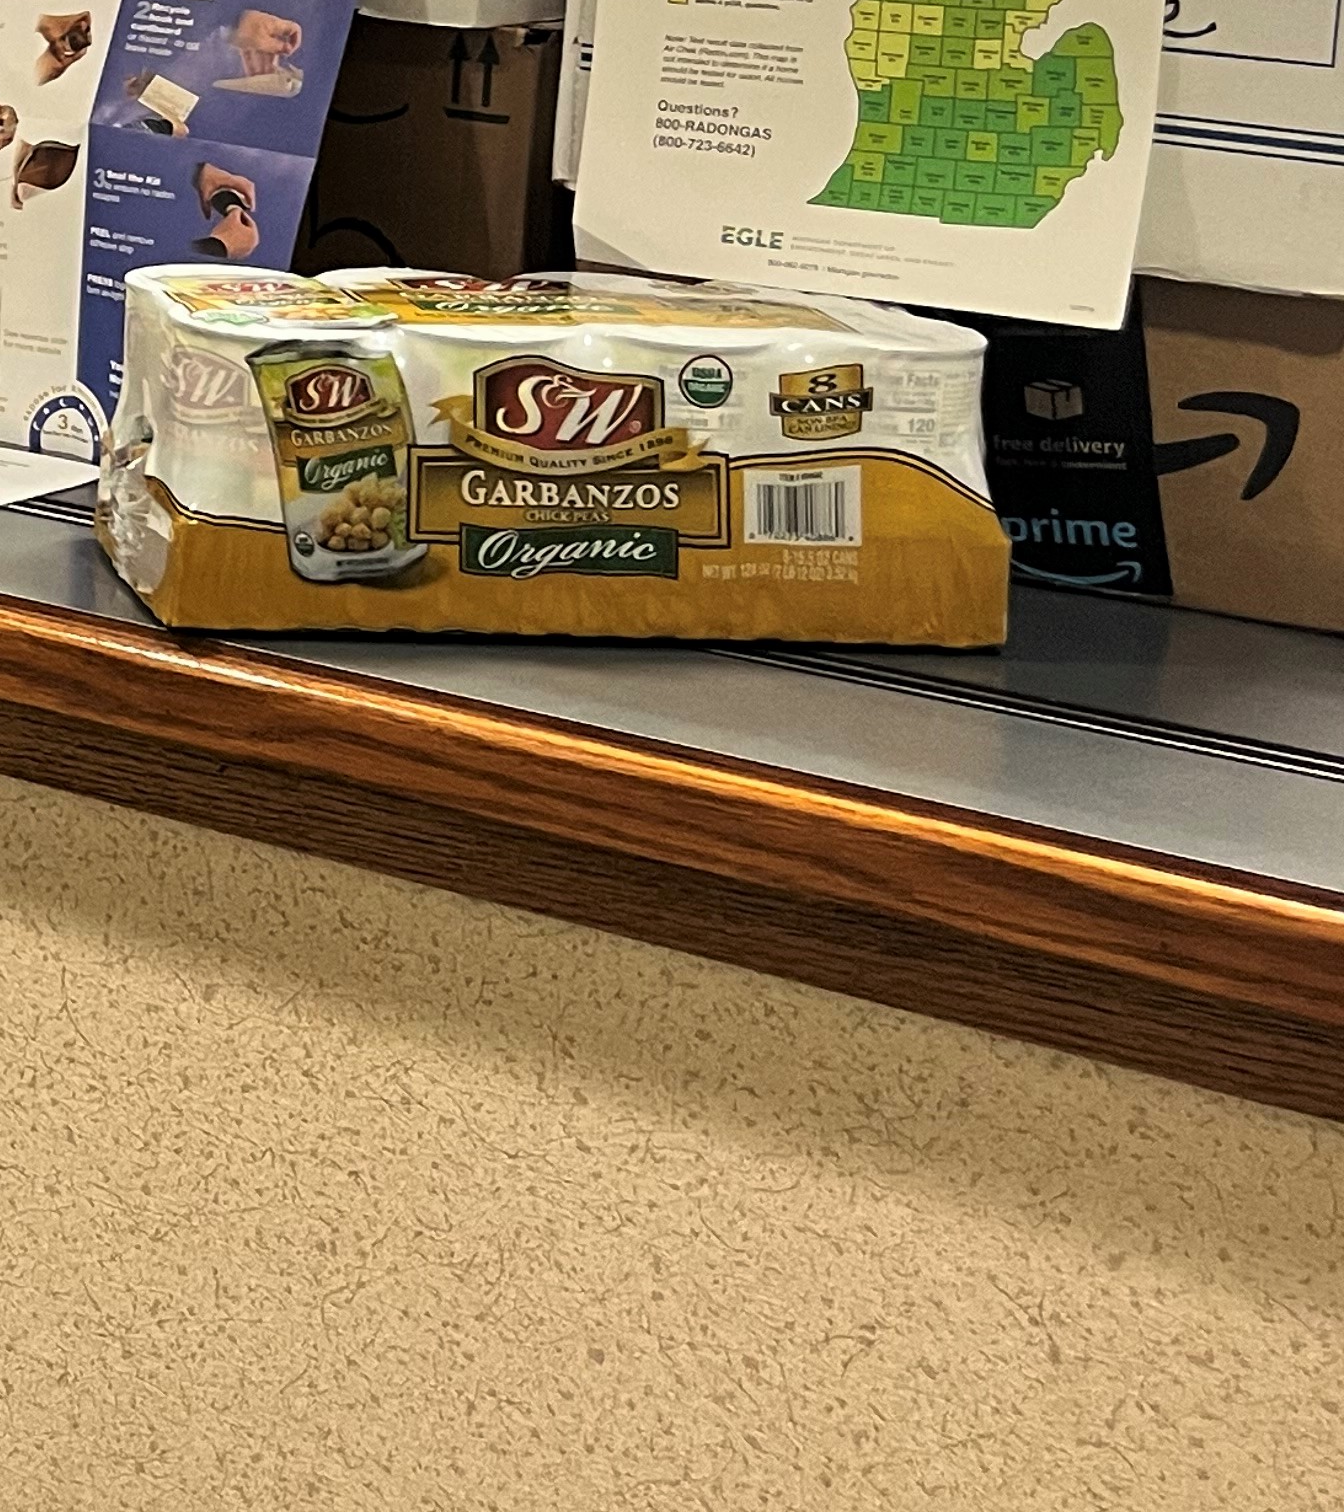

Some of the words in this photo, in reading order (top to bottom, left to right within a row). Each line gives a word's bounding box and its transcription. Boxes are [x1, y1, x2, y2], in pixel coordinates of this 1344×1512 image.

[133, 0, 152, 20] 2
[657, 99, 739, 119] Questions?
[655, 117, 773, 140] 800-RADONGAS
[652, 133, 756, 158] (800-723-6642)
[92, 167, 107, 189] 3
[721, 224, 785, 250] EGLE
[808, 373, 838, 395] 8
[496, 374, 643, 445] S&W
[781, 392, 862, 414] CANS
[57, 414, 69, 430] 3
[907, 418, 935, 434] 120
[290, 421, 393, 448] GARBANZOS
[992, 434, 1034, 452] free
[1040, 435, 1125, 458] delivery
[465, 434, 525, 465] PREMIUM
[529, 455, 588, 469] QUALITY
[593, 448, 634, 465] SINCE
[303, 448, 390, 490] Organic
[461, 469, 681, 510] GARBANZOS
[525, 509, 570, 522] CHICK
[572, 510, 610, 523] PEAS
[1000, 507, 1138, 549] prime
[477, 529, 657, 579] Organic
